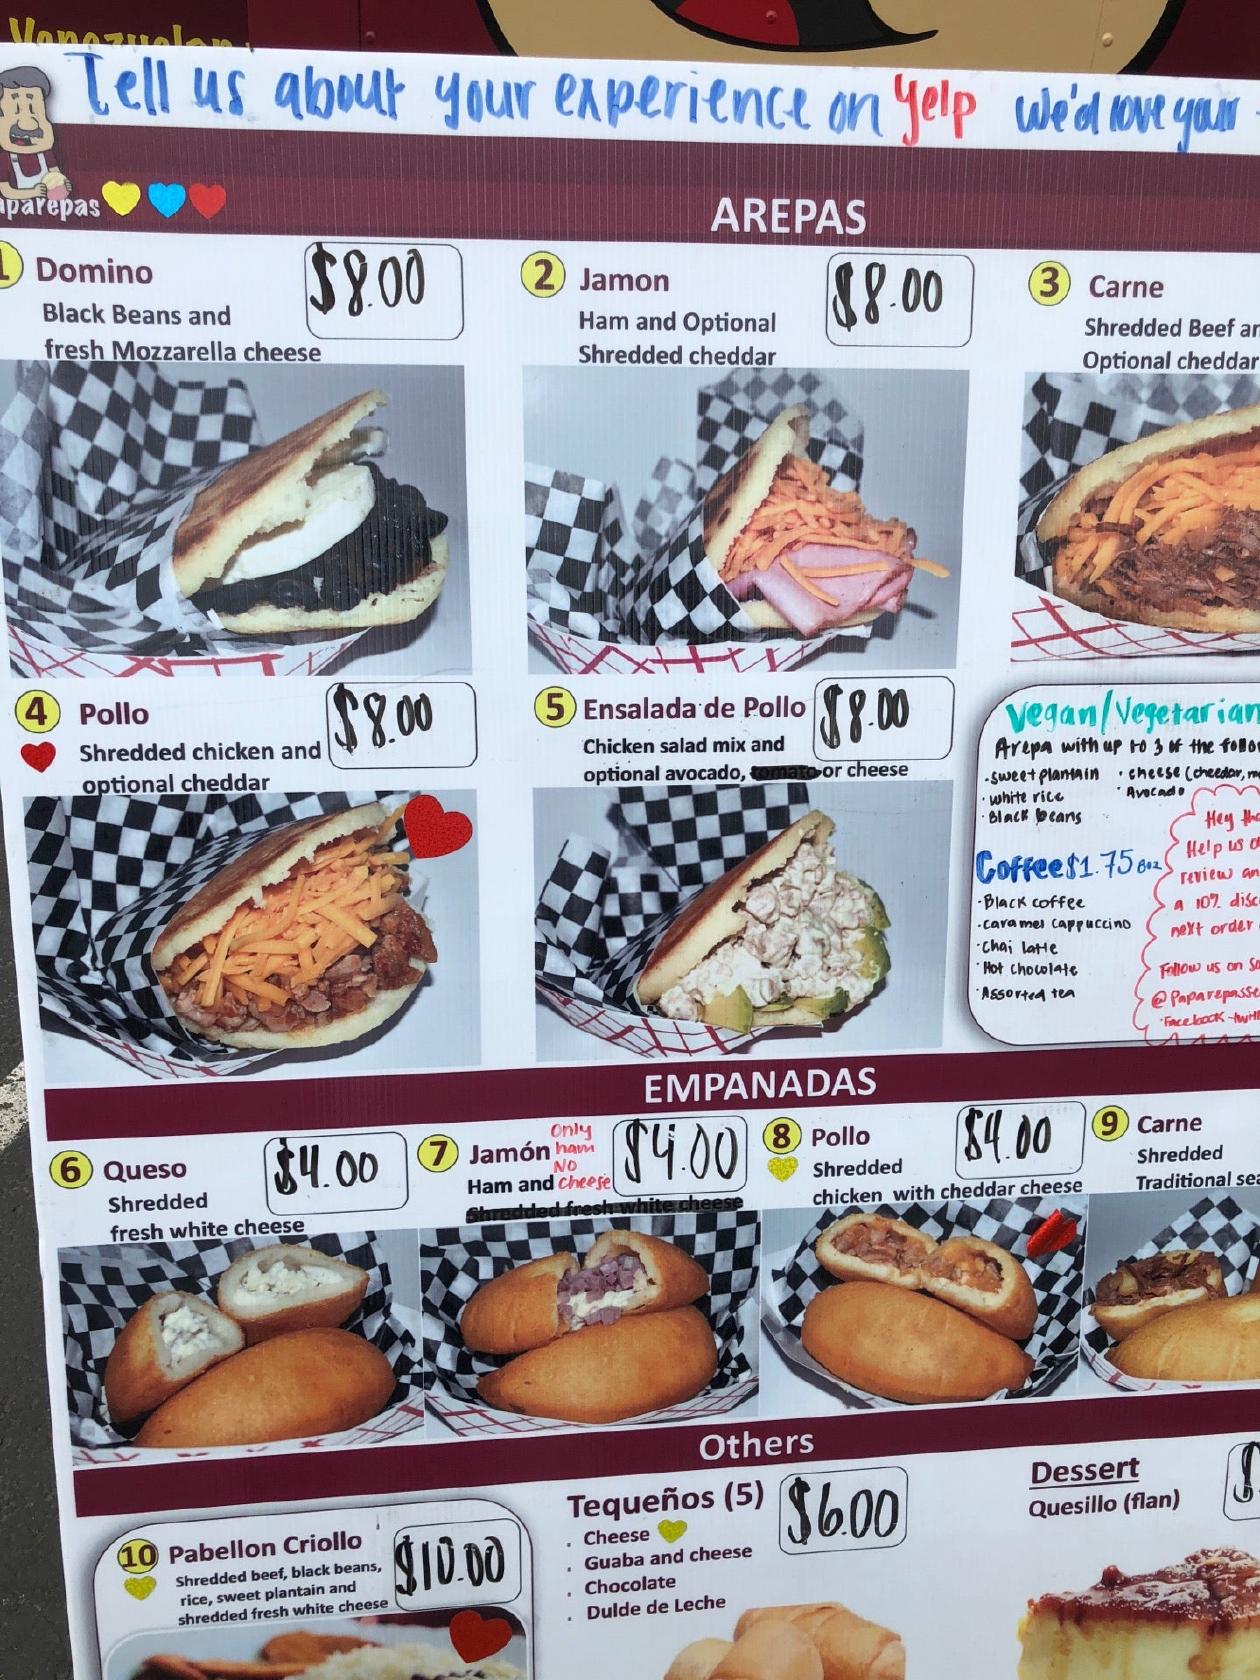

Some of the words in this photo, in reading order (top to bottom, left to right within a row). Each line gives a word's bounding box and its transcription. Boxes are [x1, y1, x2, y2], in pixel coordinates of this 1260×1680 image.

[64, 52, 170, 116] Tell
[194, 67, 245, 116] us
[275, 65, 405, 121] about
[435, 72, 536, 130] your
[555, 71, 811, 130] experience
[829, 90, 883, 137] on
[1109, 94, 1165, 134] love
[1173, 96, 1241, 153] your
[710, 197, 867, 235] AREPAS
[36, 256, 153, 285] Domino
[310, 242, 425, 317] $8.00
[534, 259, 555, 290] 2
[579, 268, 670, 292] Jamon
[1039, 266, 1060, 297] 3
[1089, 275, 1165, 298] Carne
[833, 261, 944, 332] $8.00
[43, 302, 105, 324] Black
[113, 305, 182, 326] Beans
[188, 305, 231, 326] and
[579, 312, 629, 331] Ham
[636, 312, 676, 332] and
[683, 312, 776, 336] Optional
[1085, 317, 1182, 337] Shredded
[1189, 318, 1236, 338] Beef
[45, 338, 104, 361] fresh
[113, 340, 236, 362] Mozzarella
[244, 341, 322, 362] cheese
[578, 345, 684, 365] Shredded
[689, 347, 776, 367] cheddar
[1083, 351, 1171, 374] Optional
[1177, 351, 1259, 370] cheddar
[25, 697, 47, 725] 4
[80, 702, 150, 726] Pollo
[547, 693, 564, 719] 5
[584, 698, 696, 720] Ensalada
[704, 698, 735, 719] de
[745, 697, 806, 718] Pollo
[820, 684, 909, 749] $8.00
[335, 684, 433, 755] $8.00
[80, 744, 187, 762] Shredded
[192, 743, 276, 761] chicken
[282, 741, 322, 760] and
[583, 739, 655, 755] Chicken
[660, 738, 707, 753] salad
[711, 737, 746, 752] mix
[751, 736, 785, 752] and
[995, 736, 1053, 760] Arepa
[1061, 736, 1099, 754] with
[1103, 739, 1122, 755] up
[1130, 739, 1147, 754] to
[1154, 737, 1164, 756] 3
[1169, 738, 1183, 754] of
[1189, 738, 1214, 754] the
[82, 776, 176, 797] optional
[181, 775, 270, 793] cheddar
[584, 765, 661, 786] optional
[666, 764, 746, 783] avocado,
[822, 765, 842, 778] or
[847, 761, 908, 777] cheese
[990, 767, 1036, 785] sweet
[1039, 767, 1100, 785] plantain
[1032, 790, 1065, 804] rice
[1126, 785, 1185, 799] Avocado
[989, 808, 1028, 824] Black
[1036, 808, 1082, 825] beans
[1205, 809, 1234, 832] Hey
[1187, 839, 1223, 859] Help
[1229, 838, 1244, 851] us
[975, 850, 1063, 884] Coffee
[1066, 849, 1134, 880] $1.75
[1180, 867, 1233, 885] review
[984, 893, 1027, 910] Black
[1032, 895, 1085, 911] coffee
[1174, 899, 1184, 911] a
[1170, 921, 1203, 937] next
[1211, 919, 1254, 935] order
[983, 961, 1004, 976] Hot
[1160, 961, 1201, 979] Follow
[1206, 961, 1221, 974] us
[1227, 961, 1243, 971] on
[981, 986, 1046, 1002] Assorted
[1051, 986, 1076, 999] tea
[645, 1066, 877, 1103] EMPANADAS
[551, 1123, 592, 1141] Only
[772, 1122, 791, 1148] 8
[812, 1126, 870, 1147] Pollo
[964, 1107, 1051, 1164] $4.00
[1101, 1111, 1118, 1136] 9
[1137, 1116, 1203, 1134] Carne
[429, 1141, 448, 1167] 7
[470, 1141, 550, 1165] Jamón
[556, 1141, 595, 1154] ham
[624, 1118, 738, 1184] $4.00
[1137, 1145, 1224, 1164] Shredded
[60, 1156, 81, 1183] 6
[104, 1160, 187, 1185] Queso
[274, 1137, 379, 1195] $4.00
[813, 1158, 902, 1178] Shredded
[468, 1177, 513, 1194] Ham
[519, 1174, 554, 1192] and
[813, 1187, 883, 1206] chicken
[893, 1183, 935, 1202] with
[940, 1180, 1016, 1199] cheddar
[1020, 1178, 1083, 1195] cheese
[1136, 1171, 1232, 1191] Traditional
[108, 1192, 208, 1213] Shredded
[110, 1222, 164, 1243] fresh
[169, 1220, 228, 1240] white
[234, 1217, 305, 1236] cheese
[699, 1430, 815, 1461] Others
[1031, 1457, 1140, 1484] Dessert
[567, 1487, 715, 1521] Tequeños
[724, 1479, 764, 1512] (5)
[788, 1476, 899, 1545] $6.00
[1029, 1494, 1117, 1518] Quesillo
[1124, 1488, 1180, 1515] (flan)
[122, 1544, 157, 1568] 10
[169, 1536, 279, 1564] Pabellon
[283, 1531, 363, 1557] Criollo
[583, 1528, 650, 1547] Cheese
[395, 1534, 506, 1596] $10.00
[584, 1552, 645, 1571] Guaba
[650, 1547, 684, 1565] and
[689, 1544, 753, 1562] cheese
[176, 1570, 247, 1588] Shredded
[251, 1567, 288, 1582] beef,
[292, 1563, 330, 1579] black
[334, 1561, 382, 1576] beans,
[584, 1575, 677, 1596] Chocolate
[180, 1593, 213, 1607] rice,
[217, 1589, 261, 1603] sweet
[265, 1583, 325, 1602] plantain
[329, 1580, 356, 1594] and
[178, 1608, 248, 1626] shredded
[251, 1605, 289, 1620] fresh
[293, 1601, 334, 1617] white
[338, 1598, 389, 1613] cheese
[587, 1600, 641, 1621] Dulde
[646, 1598, 669, 1616] de
[674, 1595, 727, 1614] Leche
